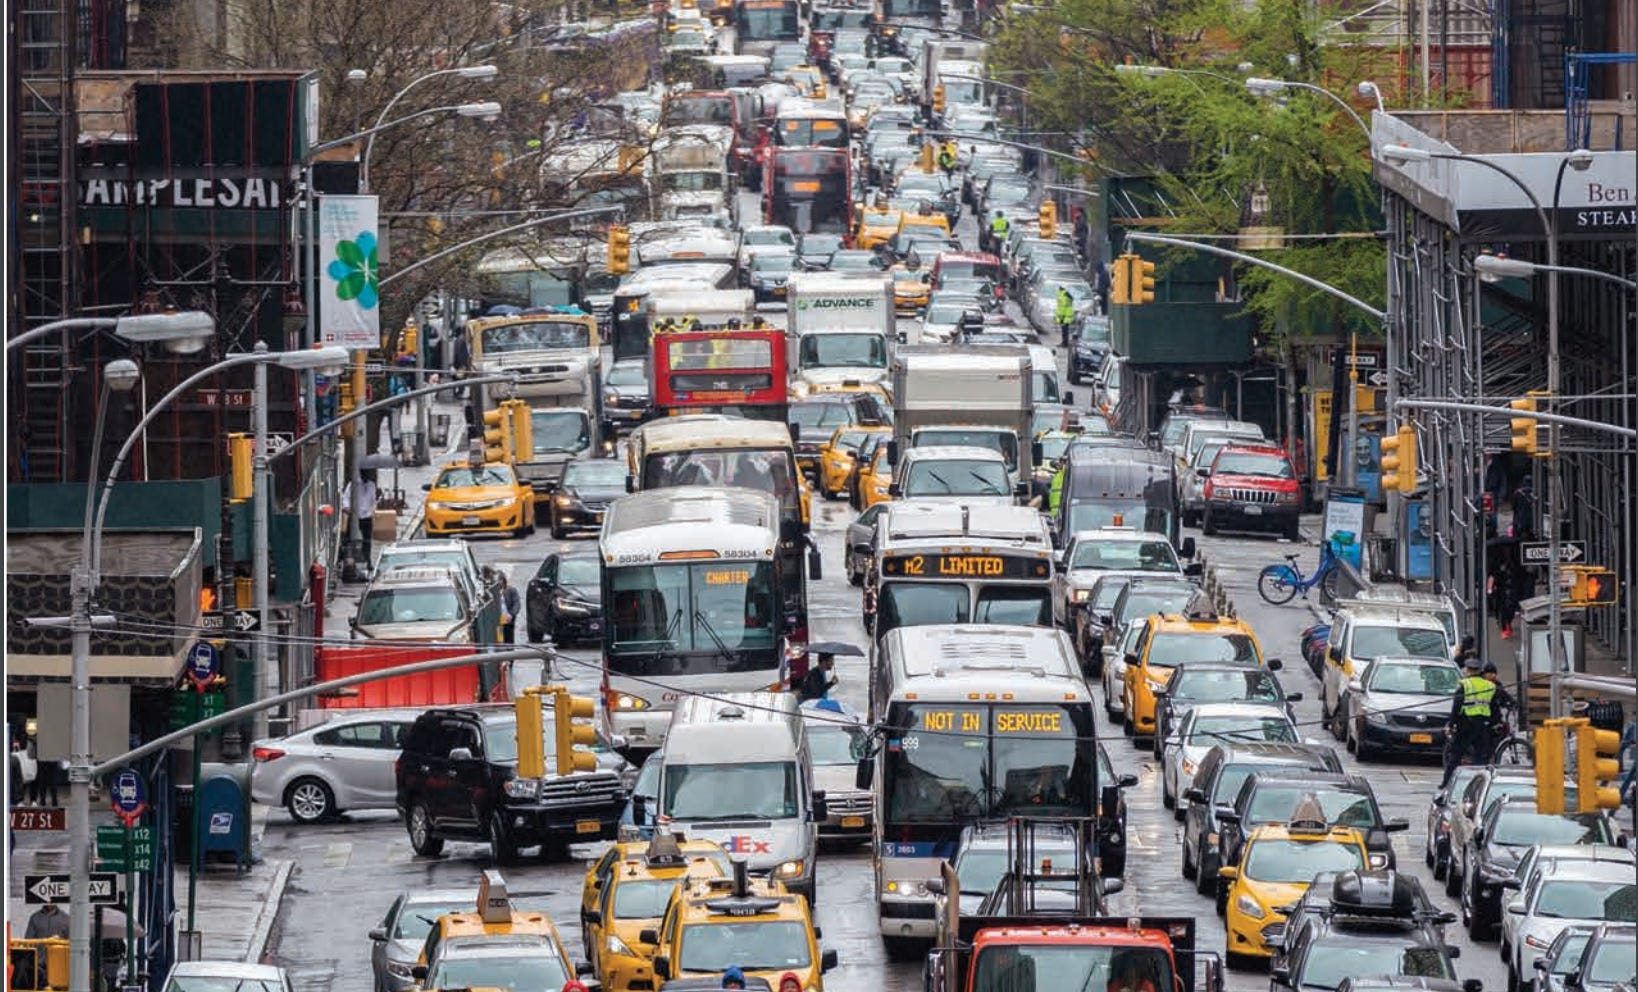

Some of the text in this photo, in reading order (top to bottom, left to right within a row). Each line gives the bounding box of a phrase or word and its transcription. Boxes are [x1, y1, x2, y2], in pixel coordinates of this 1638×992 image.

[84, 179, 281, 208] AMPLESA
[1589, 184, 1628, 202] Ben
[813, 298, 875, 308] ADVANCE
[904, 556, 1004, 575] M2 LIMITED
[706, 571, 749, 584] CHARTER
[924, 712, 1062, 732] NOT IN SERVICE
[20, 812, 34, 828] 27
[39, 812, 53, 828] St
[721, 835, 773, 854] dEx
[38, 882, 105, 895] ONE AY
